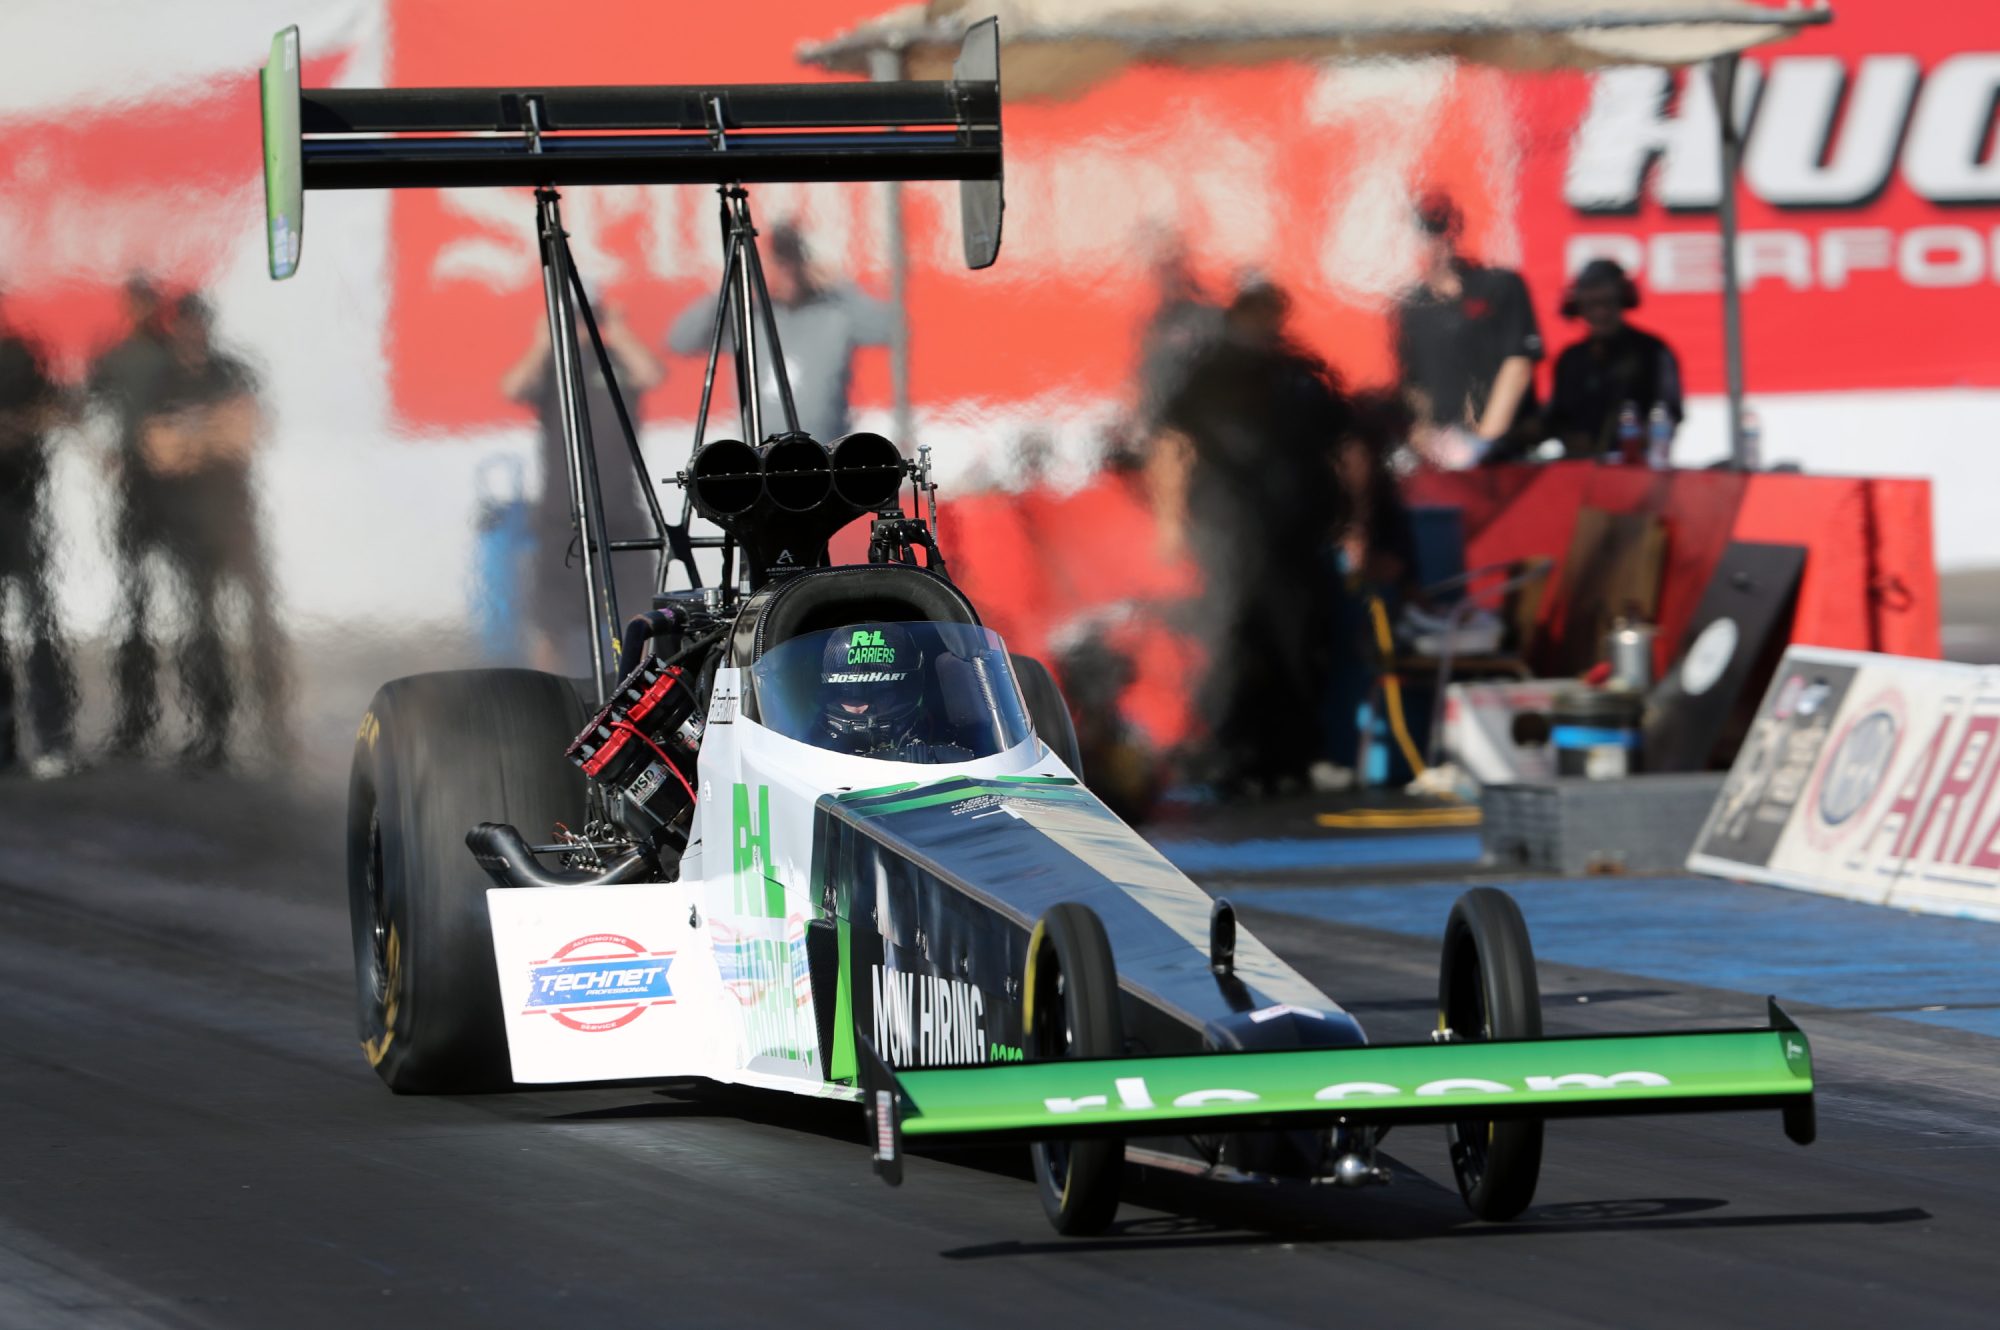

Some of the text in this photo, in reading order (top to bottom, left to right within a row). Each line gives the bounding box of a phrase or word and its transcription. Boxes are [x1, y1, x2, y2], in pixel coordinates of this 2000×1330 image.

[1565, 226, 2000, 293] PERFO
[847, 647, 896, 665] CARRIERS
[629, 769, 655, 797] MSD
[572, 937, 627, 947] AUTOMOTIVE
[585, 986, 649, 996] PROFESSIONAL
[580, 1021, 617, 1030] SERVICE
[920, 974, 986, 1066] HIRING
